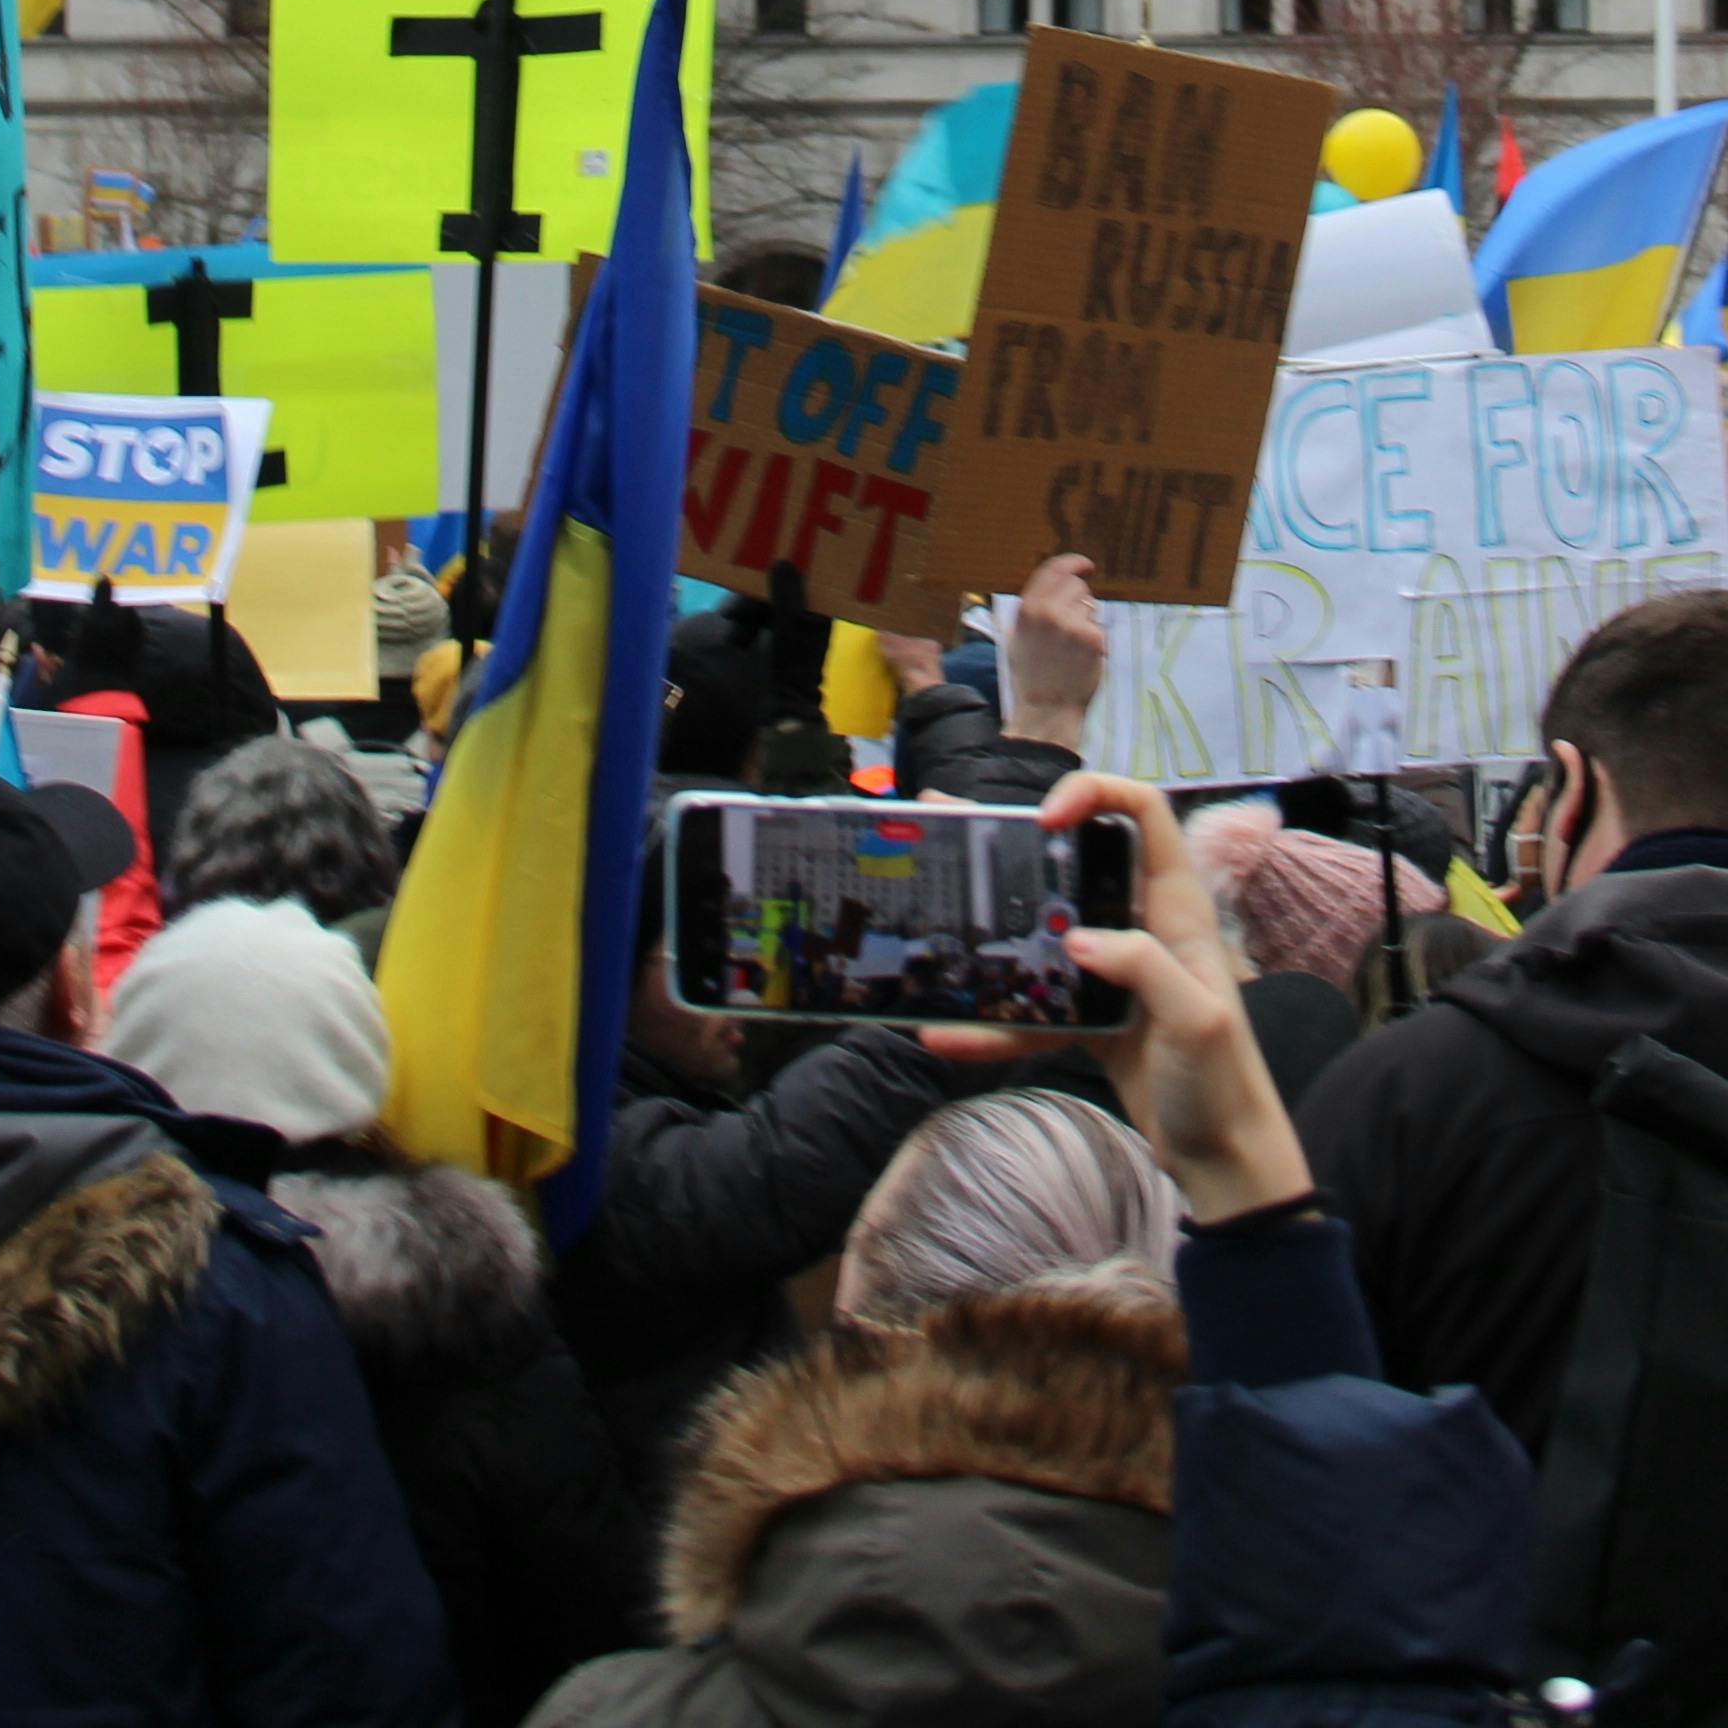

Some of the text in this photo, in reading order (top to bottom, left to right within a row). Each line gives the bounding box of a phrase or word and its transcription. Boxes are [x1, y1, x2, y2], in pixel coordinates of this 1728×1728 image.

[38, 418, 225, 487] STOP
[776, 334, 962, 476] OFF
[1246, 355, 1702, 553] CE FOR
[33, 515, 214, 576] WAR
